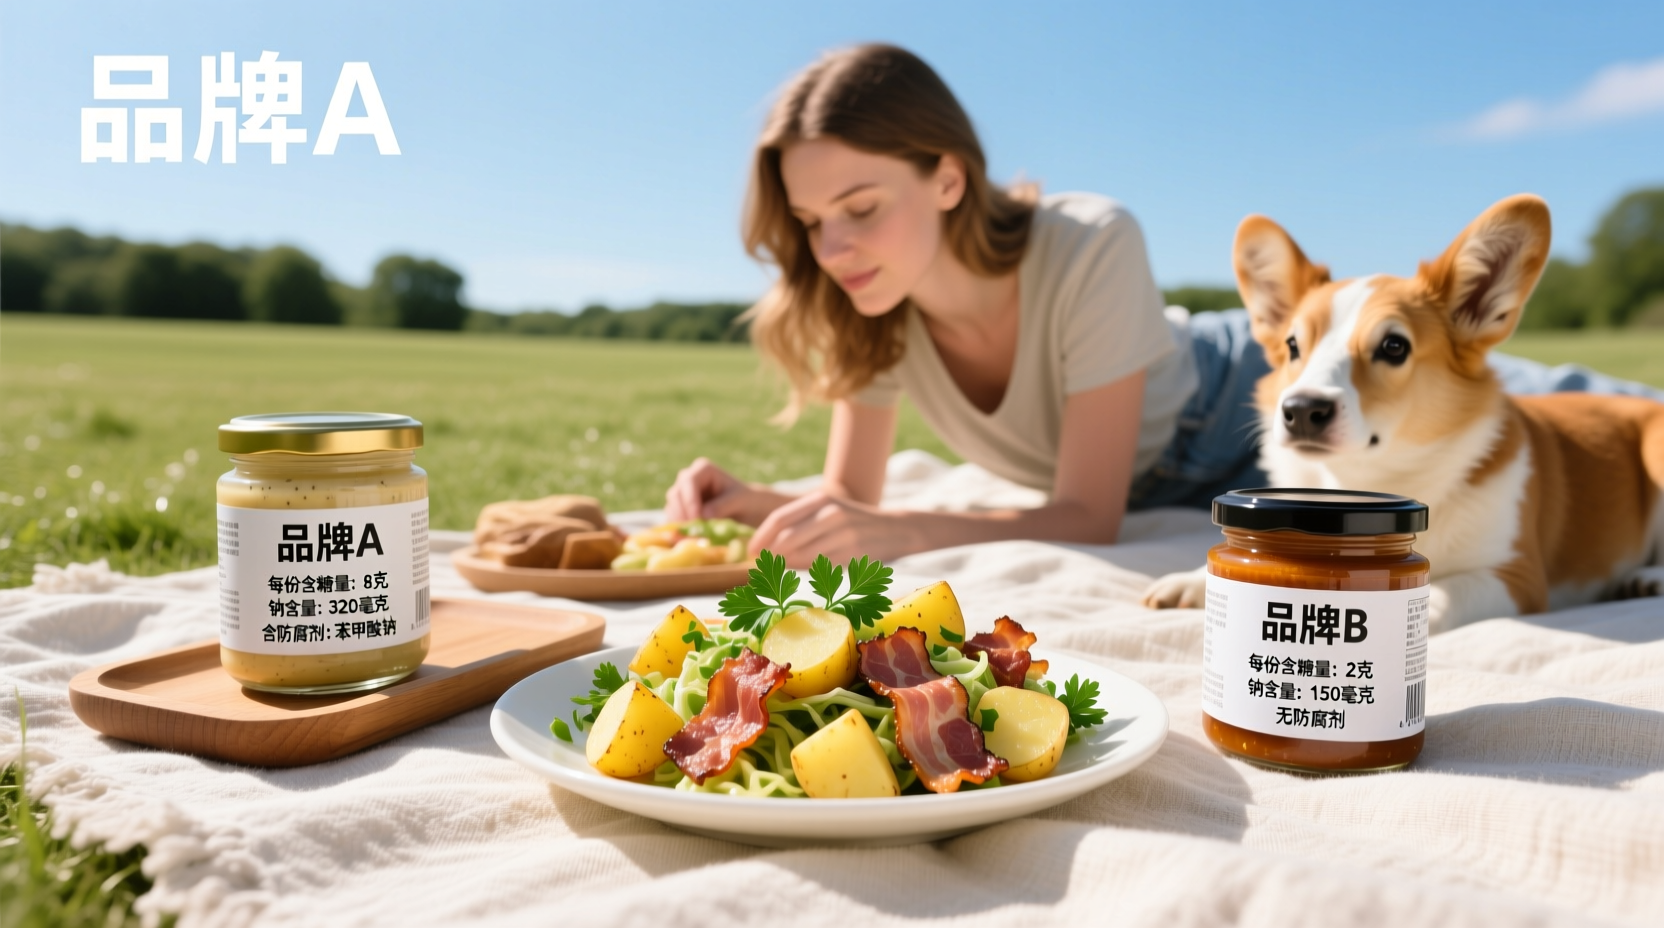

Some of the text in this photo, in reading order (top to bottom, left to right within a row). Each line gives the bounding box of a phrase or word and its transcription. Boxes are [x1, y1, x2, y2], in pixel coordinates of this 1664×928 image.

[278, 522, 383, 562] 品牌A
[1262, 602, 1367, 645] 品牌B
[1276, 706, 1346, 730] 无防腐剂
